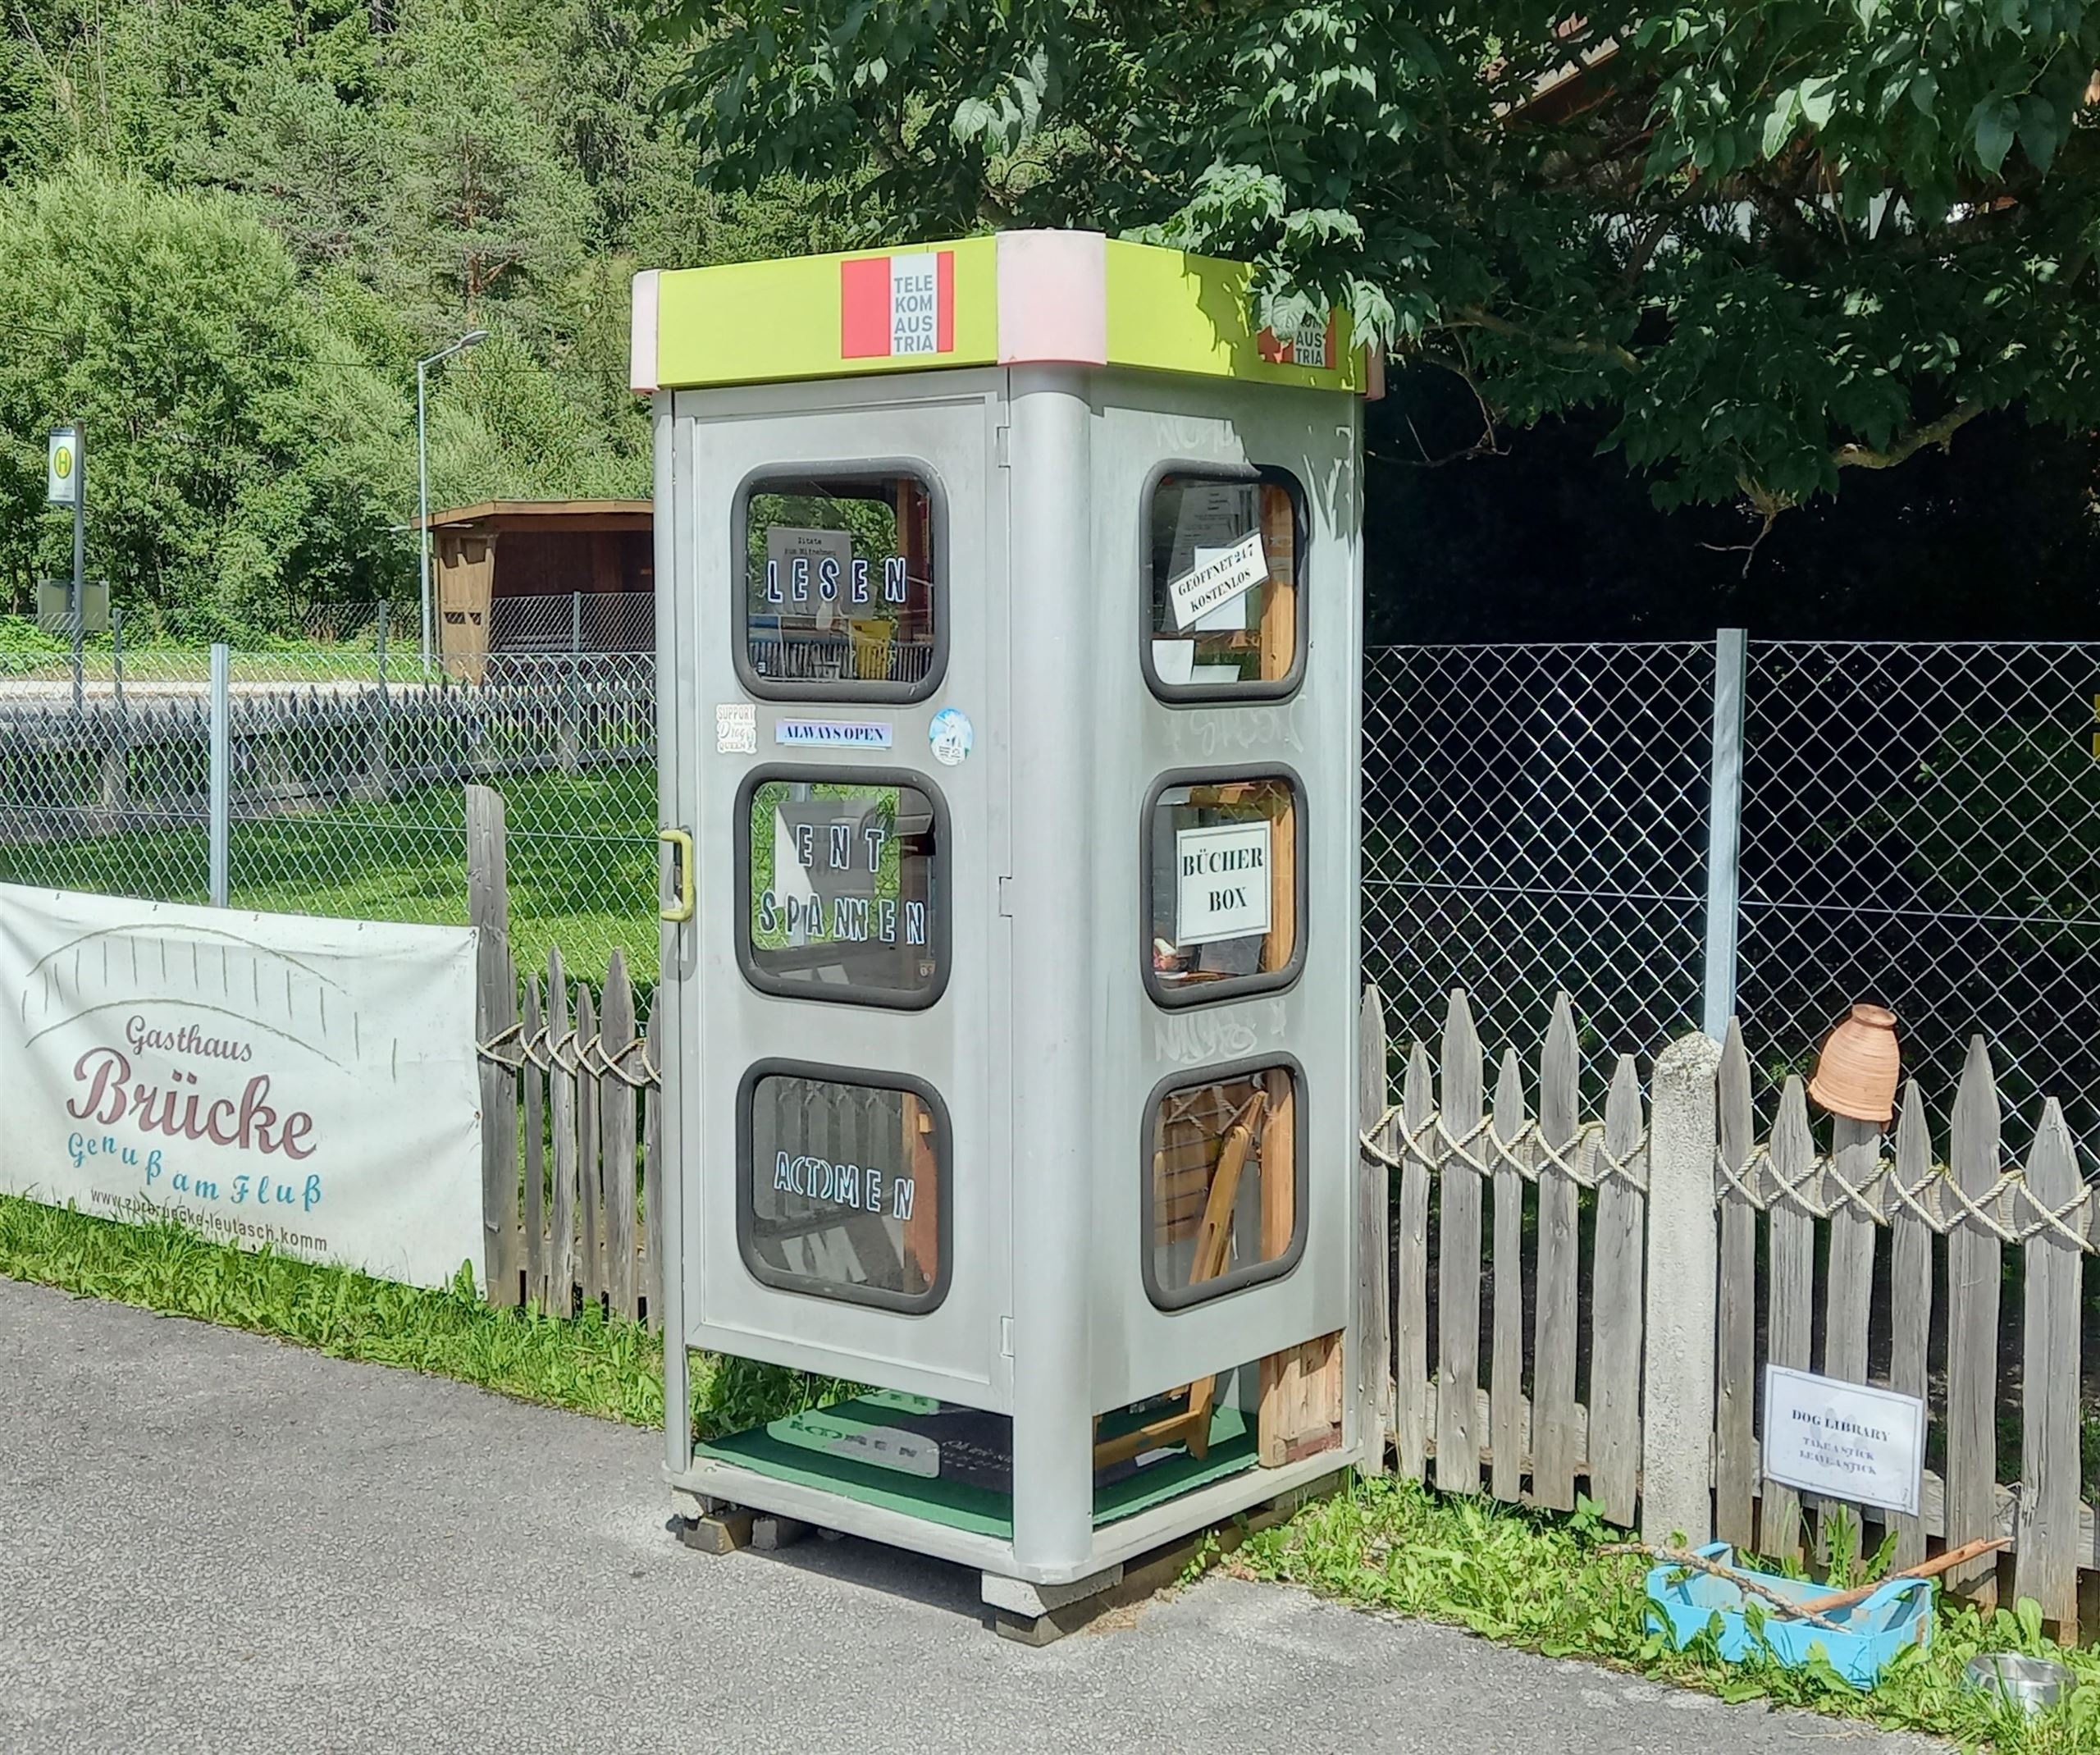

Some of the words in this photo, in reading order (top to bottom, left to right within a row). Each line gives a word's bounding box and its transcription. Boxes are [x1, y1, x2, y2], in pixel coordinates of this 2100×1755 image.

[893, 275, 933, 294] TELE
[895, 295, 933, 313] KOM
[894, 315, 933, 334] AUS
[893, 335, 934, 352] TRIA
[1296, 331, 1322, 348] AUS
[1295, 348, 1323, 366] TRIA
[58, 452, 67, 473] H
[768, 557, 906, 603] LESEN
[1178, 555, 1233, 596] GEÖFFNET
[1189, 568, 1252, 613] KOSTENLOS
[718, 706, 754, 720] SUPPORT
[785, 725, 841, 739] ALWAYS
[844, 727, 883, 742] OPEN
[797, 824, 885, 872] ENT
[1183, 847, 1263, 877] BÜCHER
[1208, 886, 1248, 912] BOX
[126, 1015, 253, 1062] Gasthaus
[66, 1046, 317, 1160] Brücke
[68, 1131, 162, 1186] Genuß
[172, 1172, 220, 1201] am
[231, 1174, 322, 1213] Fluß
[1792, 1409, 1821, 1426] DOG
[1825, 1418, 1890, 1442] LIBRARY
[1803, 1437, 1831, 1451] TAKE
[1841, 1447, 1874, 1461] STICK
[1800, 1450, 1833, 1465] LEAVE
[1842, 1461, 1877, 1476] STICK
